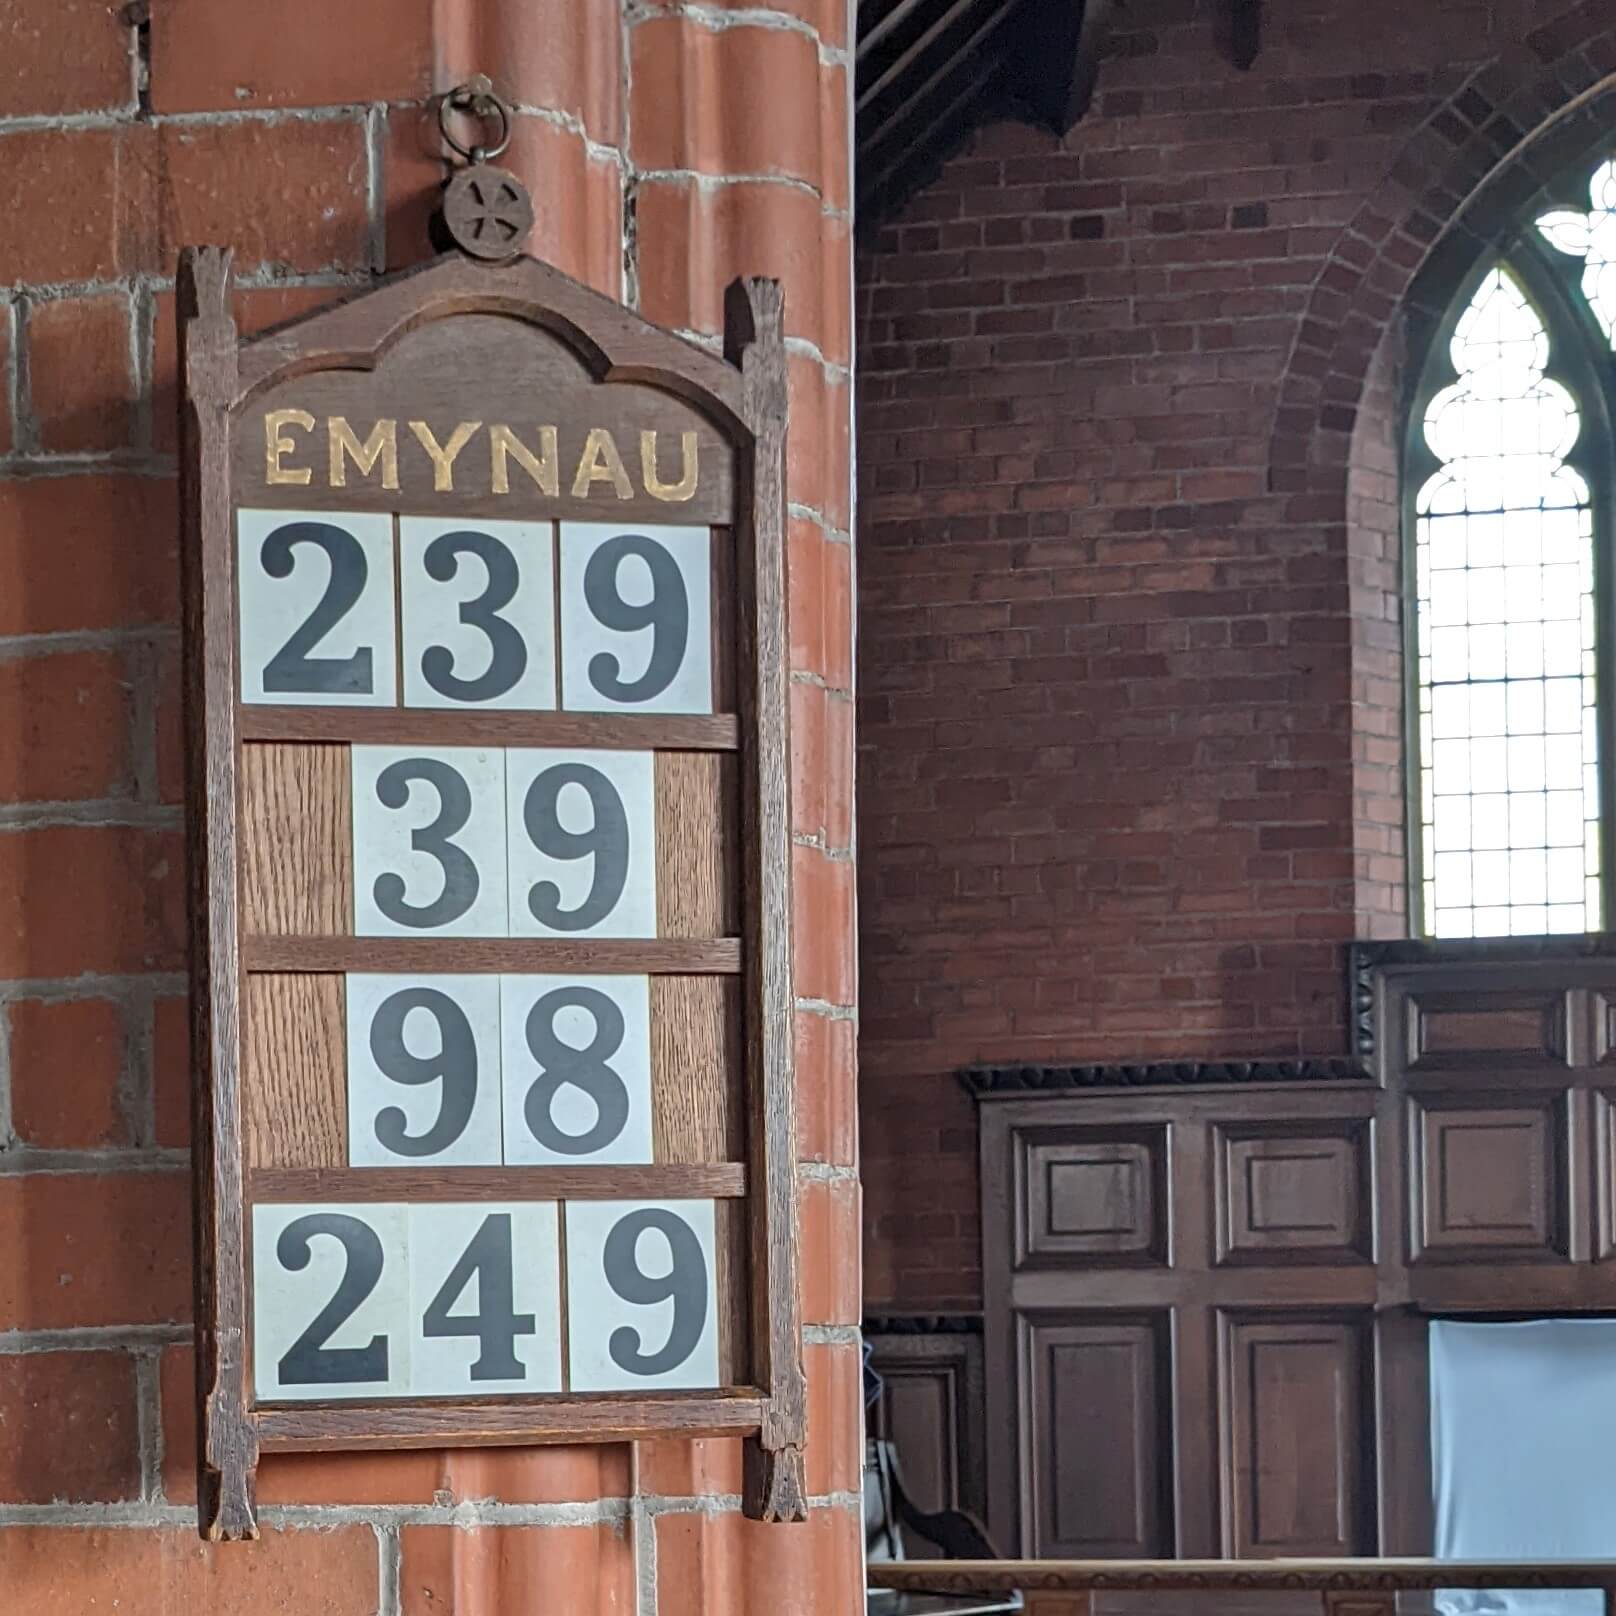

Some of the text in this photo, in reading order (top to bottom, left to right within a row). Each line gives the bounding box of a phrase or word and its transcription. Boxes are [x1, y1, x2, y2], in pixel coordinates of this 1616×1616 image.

[265, 409, 698, 501] EMYNAU
[260, 521, 689, 702] 239
[373, 757, 630, 931] 39
[369, 985, 630, 1157] 98
[276, 1207, 708, 1385] 249
